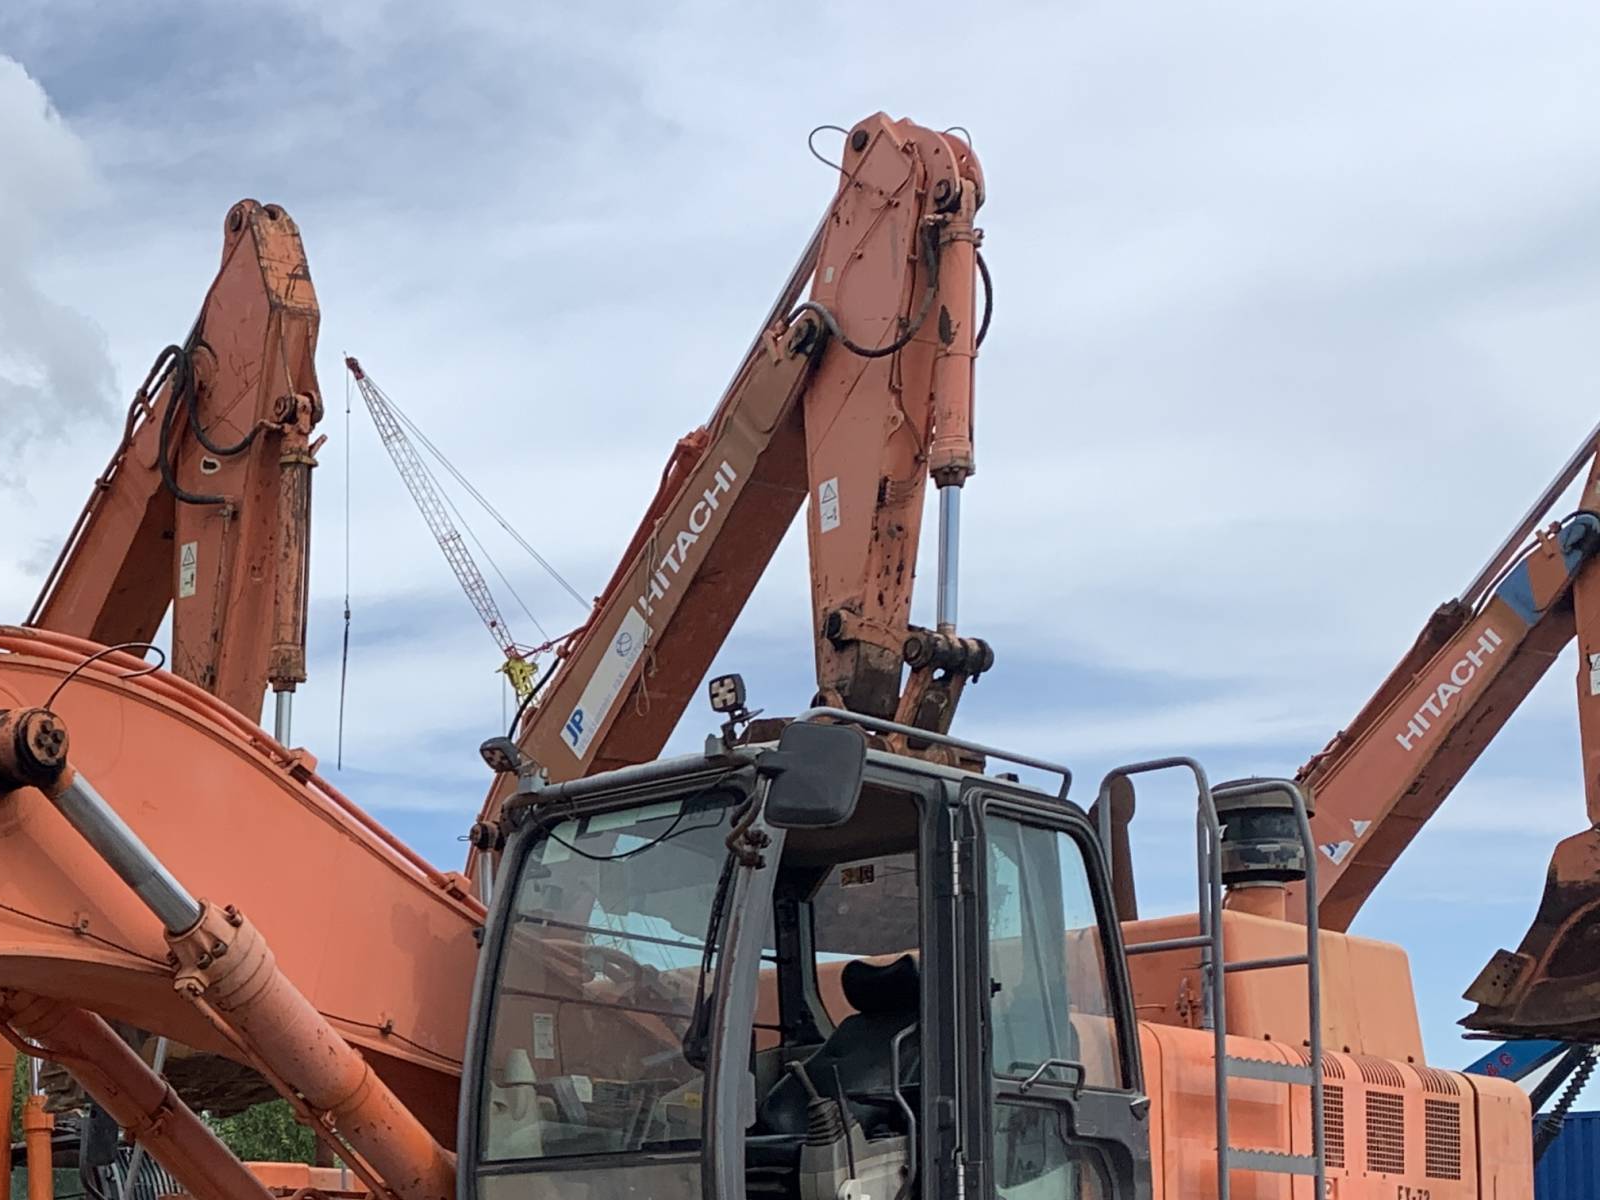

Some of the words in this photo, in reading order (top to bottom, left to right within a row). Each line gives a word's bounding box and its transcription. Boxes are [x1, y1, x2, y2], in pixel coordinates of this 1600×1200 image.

[638, 460, 737, 616] HITACHI
[566, 709, 584, 746] JP
[1395, 627, 1503, 751] HITACHI
